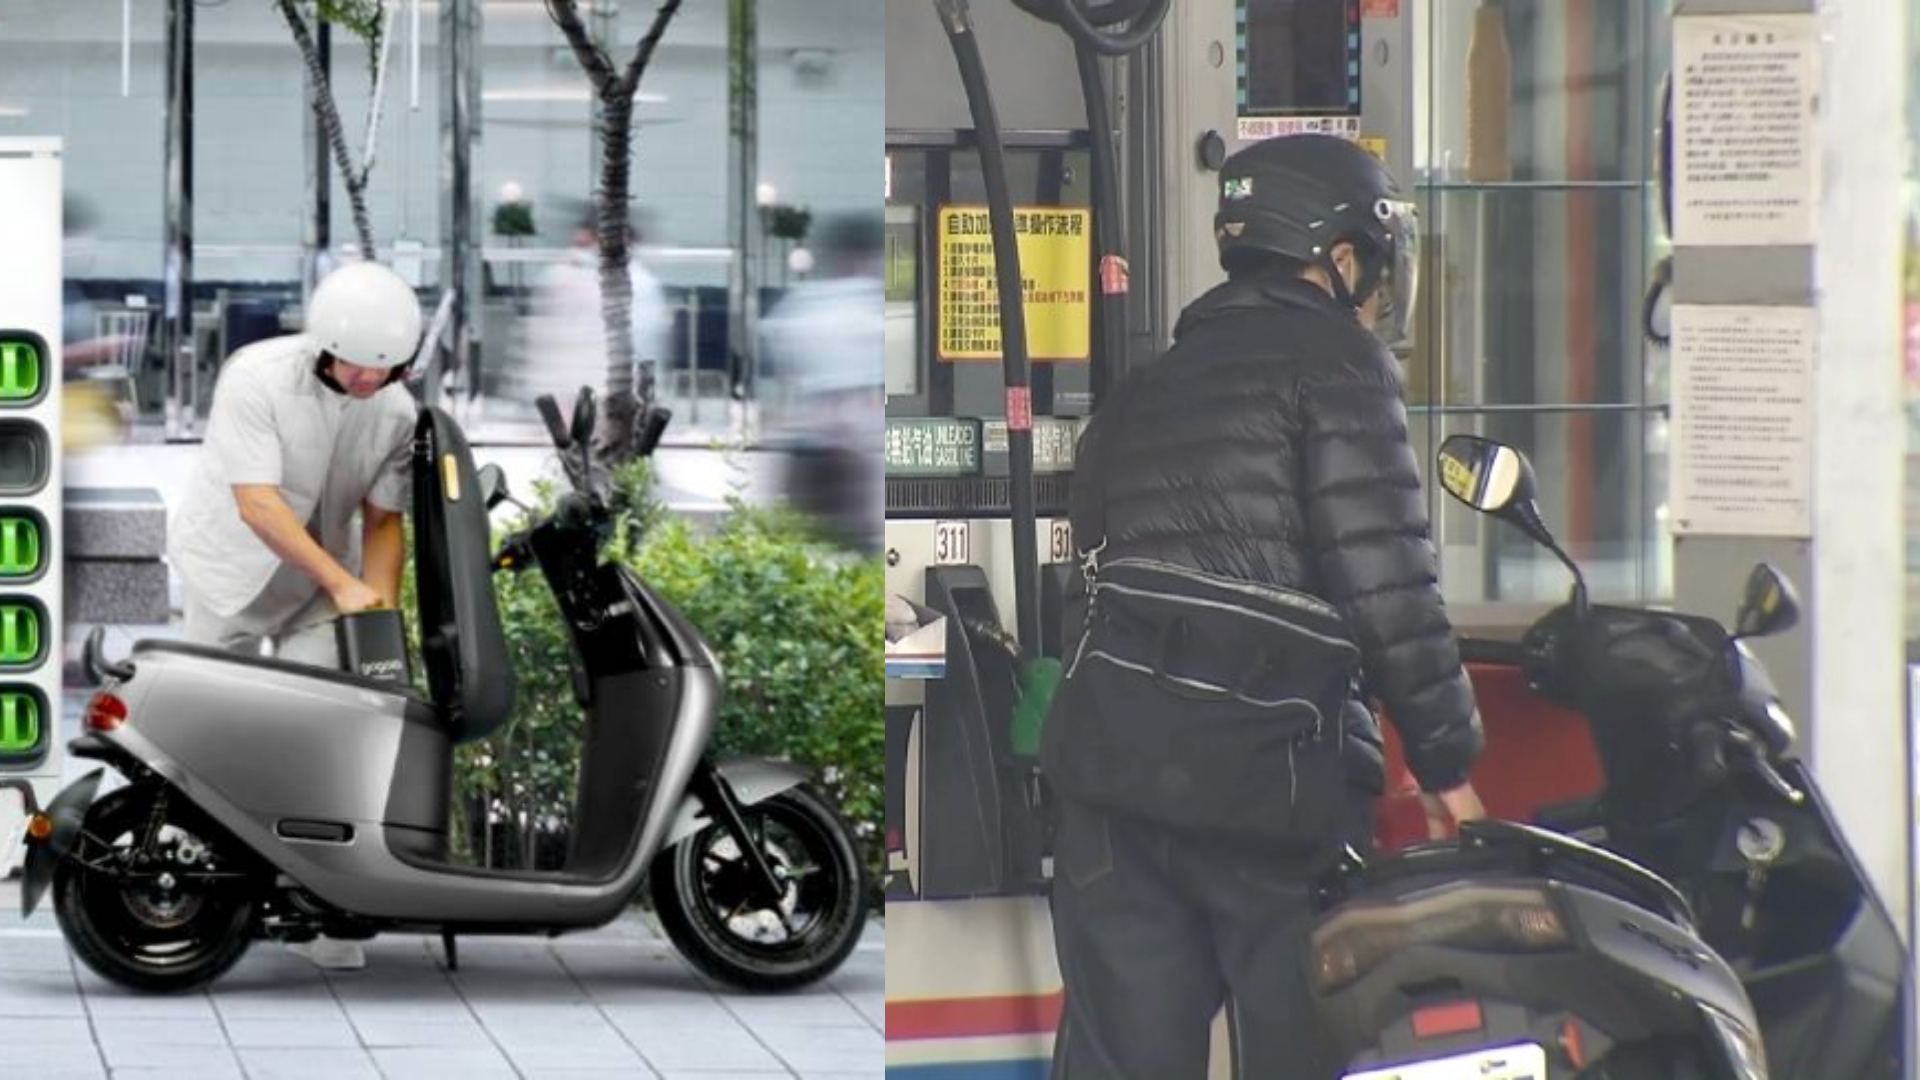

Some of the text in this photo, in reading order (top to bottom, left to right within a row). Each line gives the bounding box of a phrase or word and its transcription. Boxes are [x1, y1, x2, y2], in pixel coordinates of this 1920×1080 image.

[935, 425, 974, 444] UNLEADED
[935, 448, 974, 467] GASOLINE
[938, 527, 965, 559] 311
